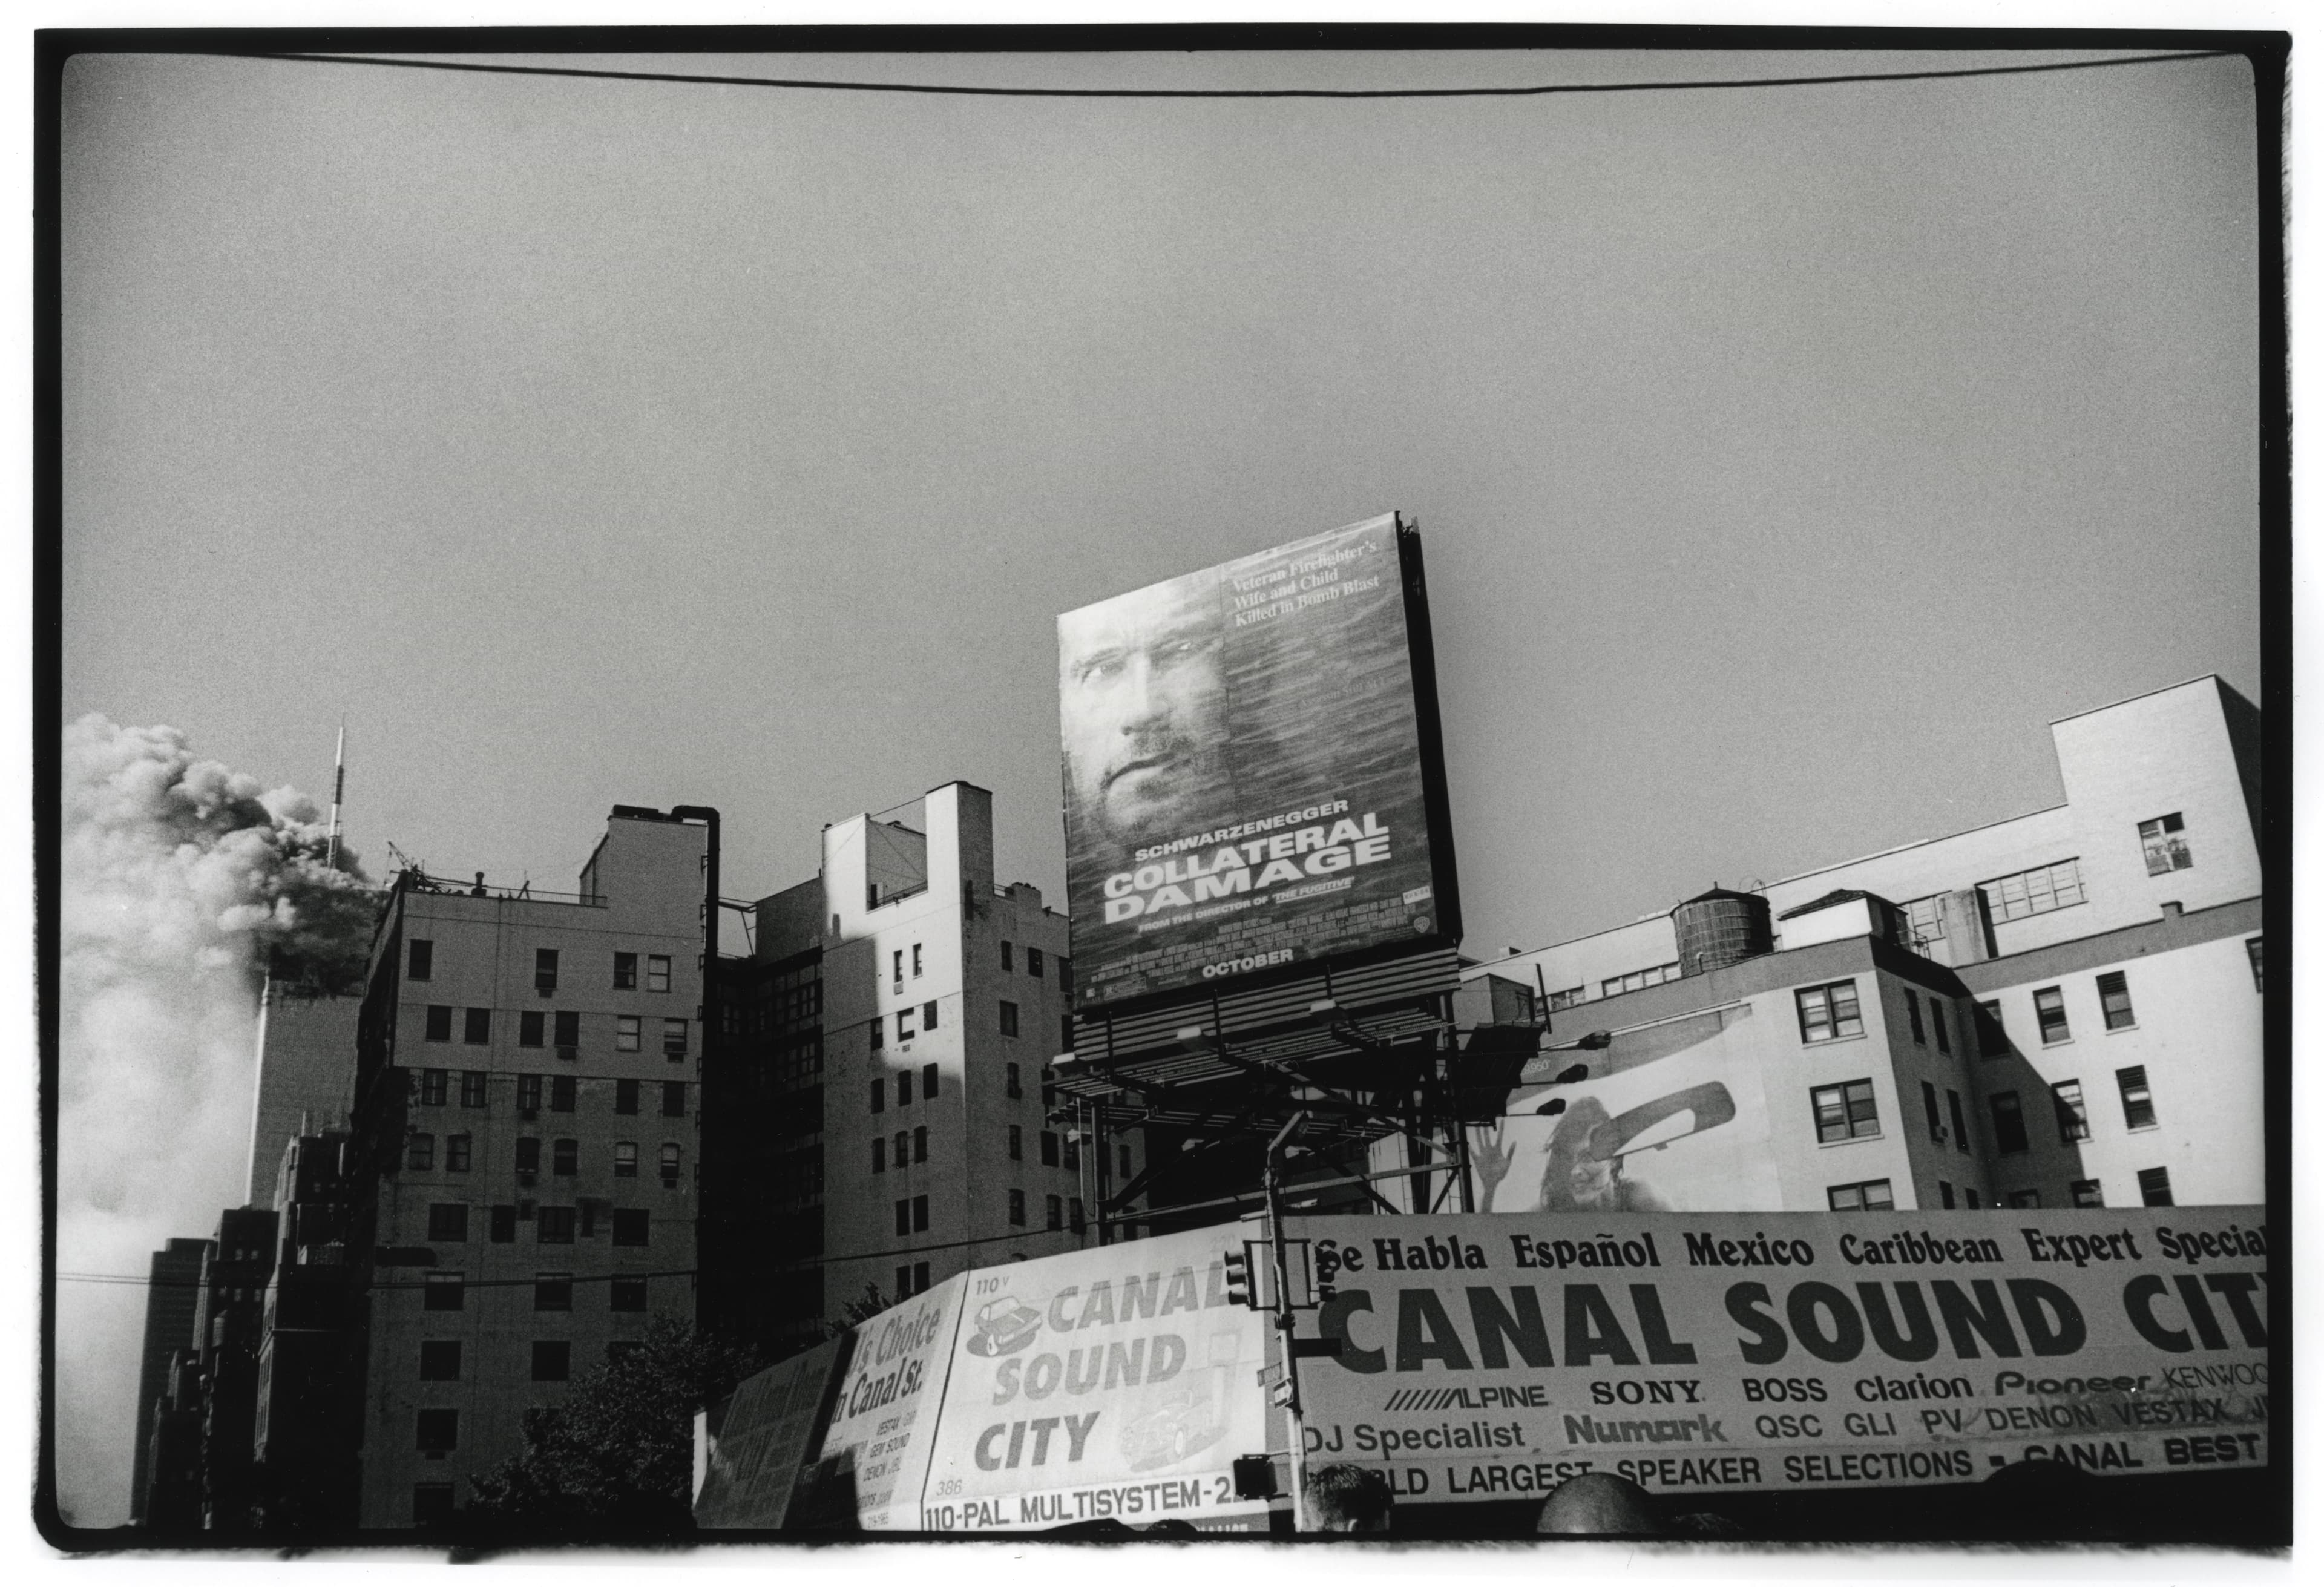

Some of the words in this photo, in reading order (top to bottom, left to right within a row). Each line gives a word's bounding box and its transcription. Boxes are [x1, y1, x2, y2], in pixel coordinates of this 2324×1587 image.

[1232, 570, 1286, 593] Veteran
[1288, 540, 1377, 575] Firefighter's
[1234, 589, 1267, 610] Wife
[1270, 583, 1296, 600] and
[1300, 569, 1338, 591] Child
[1235, 606, 1276, 628] Killed
[1279, 600, 1293, 614] in
[1297, 586, 1340, 609] Bomb
[1343, 575, 1380, 595] Blast
[1104, 812, 1389, 899] COLLATERAL
[1134, 799, 1348, 862] SCHWARZENEGGER
[1105, 835, 1391, 924] DAMAGE
[1138, 918, 1170, 933] FROM
[1172, 912, 1193, 926] THE
[1196, 897, 1250, 919] DIRECTOR
[1253, 894, 1269, 907] OF
[1203, 948, 1294, 979] OCTOBER
[1373, 1235, 1488, 1271] Habla
[1510, 1232, 1661, 1269] Español
[1683, 1232, 1814, 1266] Mexico
[1840, 1230, 2004, 1266] Caribbean
[2021, 1227, 2142, 1268] Expert
[977, 1276, 999, 1295] 110
[1048, 1260, 1233, 1332] CANAL
[876, 1303, 940, 1365] Choice
[1319, 1283, 1698, 1374] CANAL
[1725, 1278, 2087, 1365] SOUND
[2123, 1272, 2268, 1353] CIT
[849, 1356, 907, 1418] Canal
[991, 1333, 1186, 1407] SOUND
[1743, 1378, 1828, 1402] BOSS
[1995, 1370, 2152, 1397] Pioneer
[974, 1411, 1100, 1472] CITY
[1305, 1426, 1342, 1453] DJ
[1354, 1421, 1525, 1460] Specialist
[1563, 1414, 1728, 1444] Numark
[1756, 1413, 1823, 1439] QSC
[1845, 1412, 1897, 1437] GLI
[1922, 1409, 1963, 1435] PV
[1985, 1404, 2098, 1431] DENON
[2115, 1397, 2229, 1425] VESTAX
[936, 1479, 962, 1496] 386
[1448, 1461, 1593, 1494] LARGEST
[1617, 1456, 1761, 1486] SPEAKER
[1785, 1450, 1973, 1483] SELECTIONS
[2164, 1433, 2260, 1462] BEST
[926, 1499, 1009, 1530] 110-PAL
[1021, 1476, 1238, 1523] MULTISYSTEM-2
